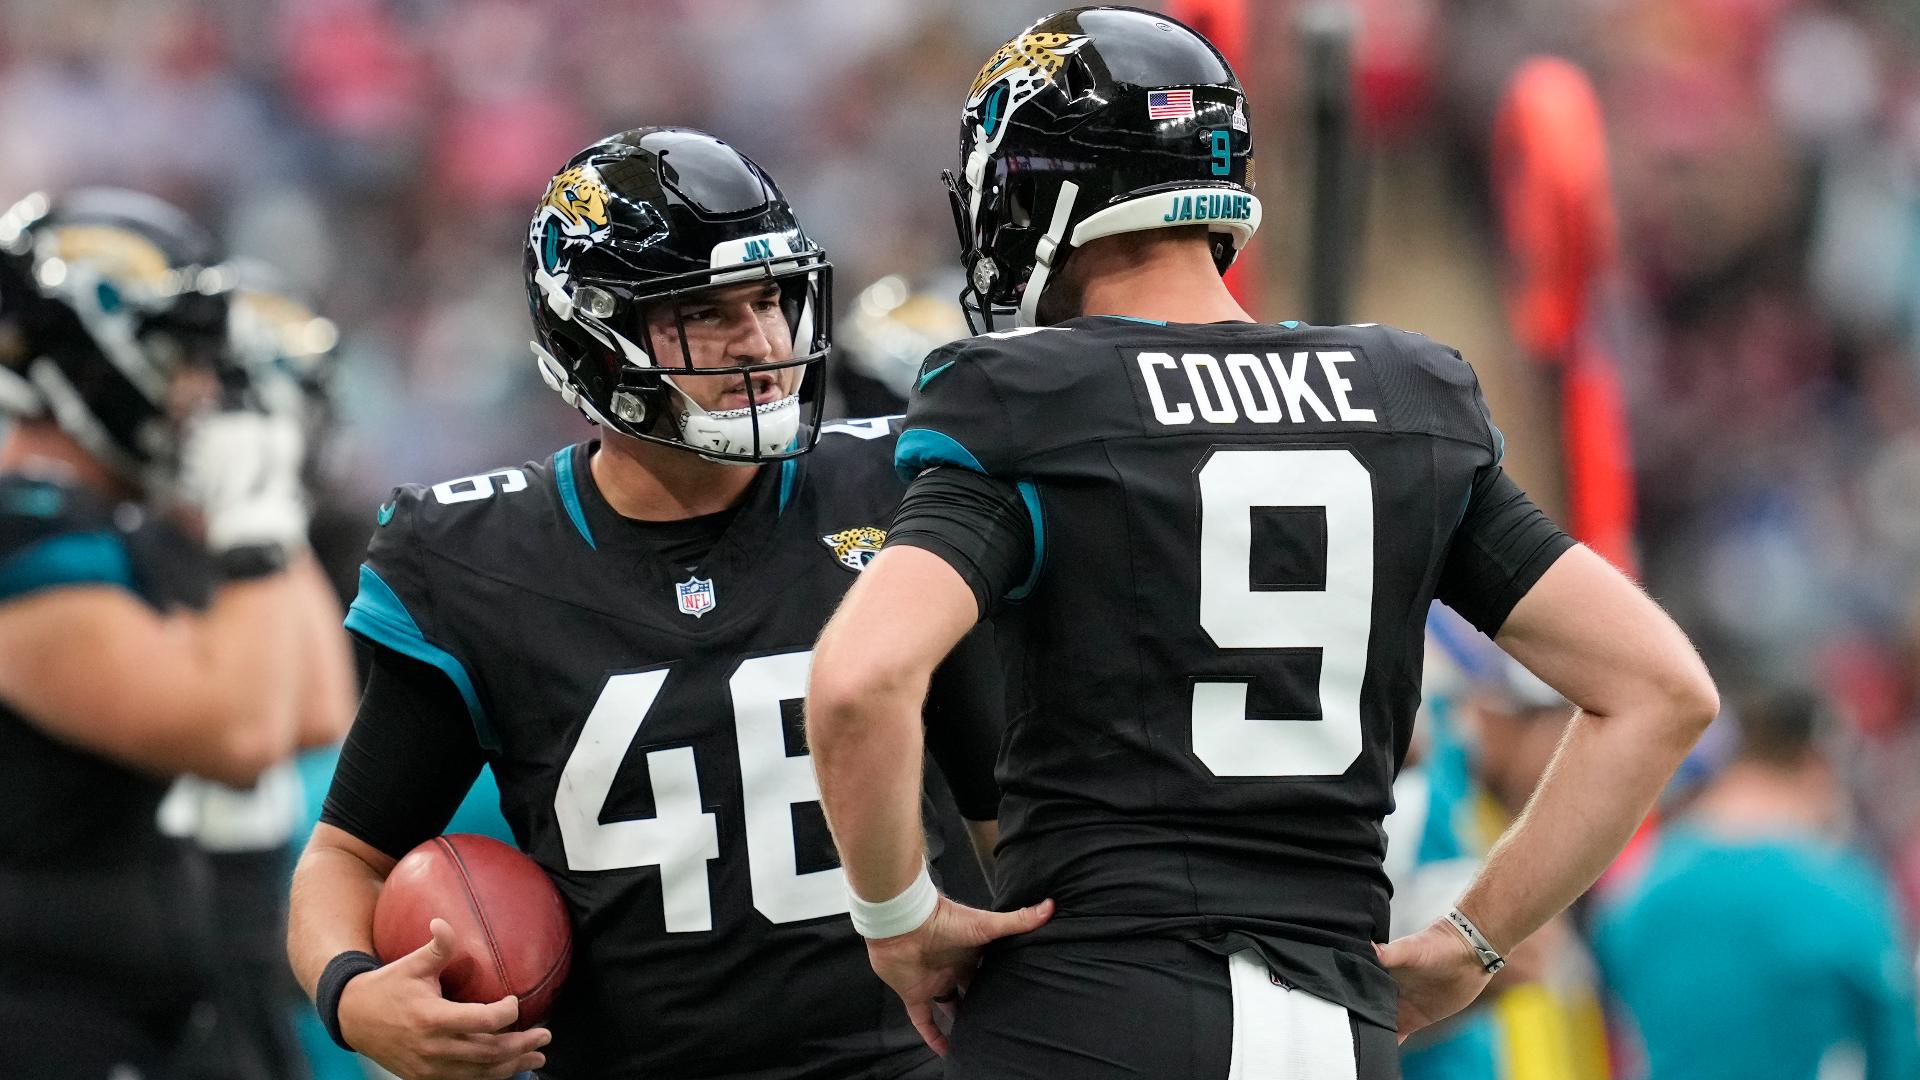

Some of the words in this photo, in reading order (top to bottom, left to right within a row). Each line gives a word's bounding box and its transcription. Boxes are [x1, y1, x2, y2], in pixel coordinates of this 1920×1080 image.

[1212, 130, 1230, 175] 9
[1164, 194, 1251, 222] JAGUARS
[743, 238, 774, 262] JAX
[1137, 351, 1377, 425] COOKE
[684, 593, 709, 609] NFL
[1192, 450, 1374, 776] 9
[554, 650, 851, 933] 46
